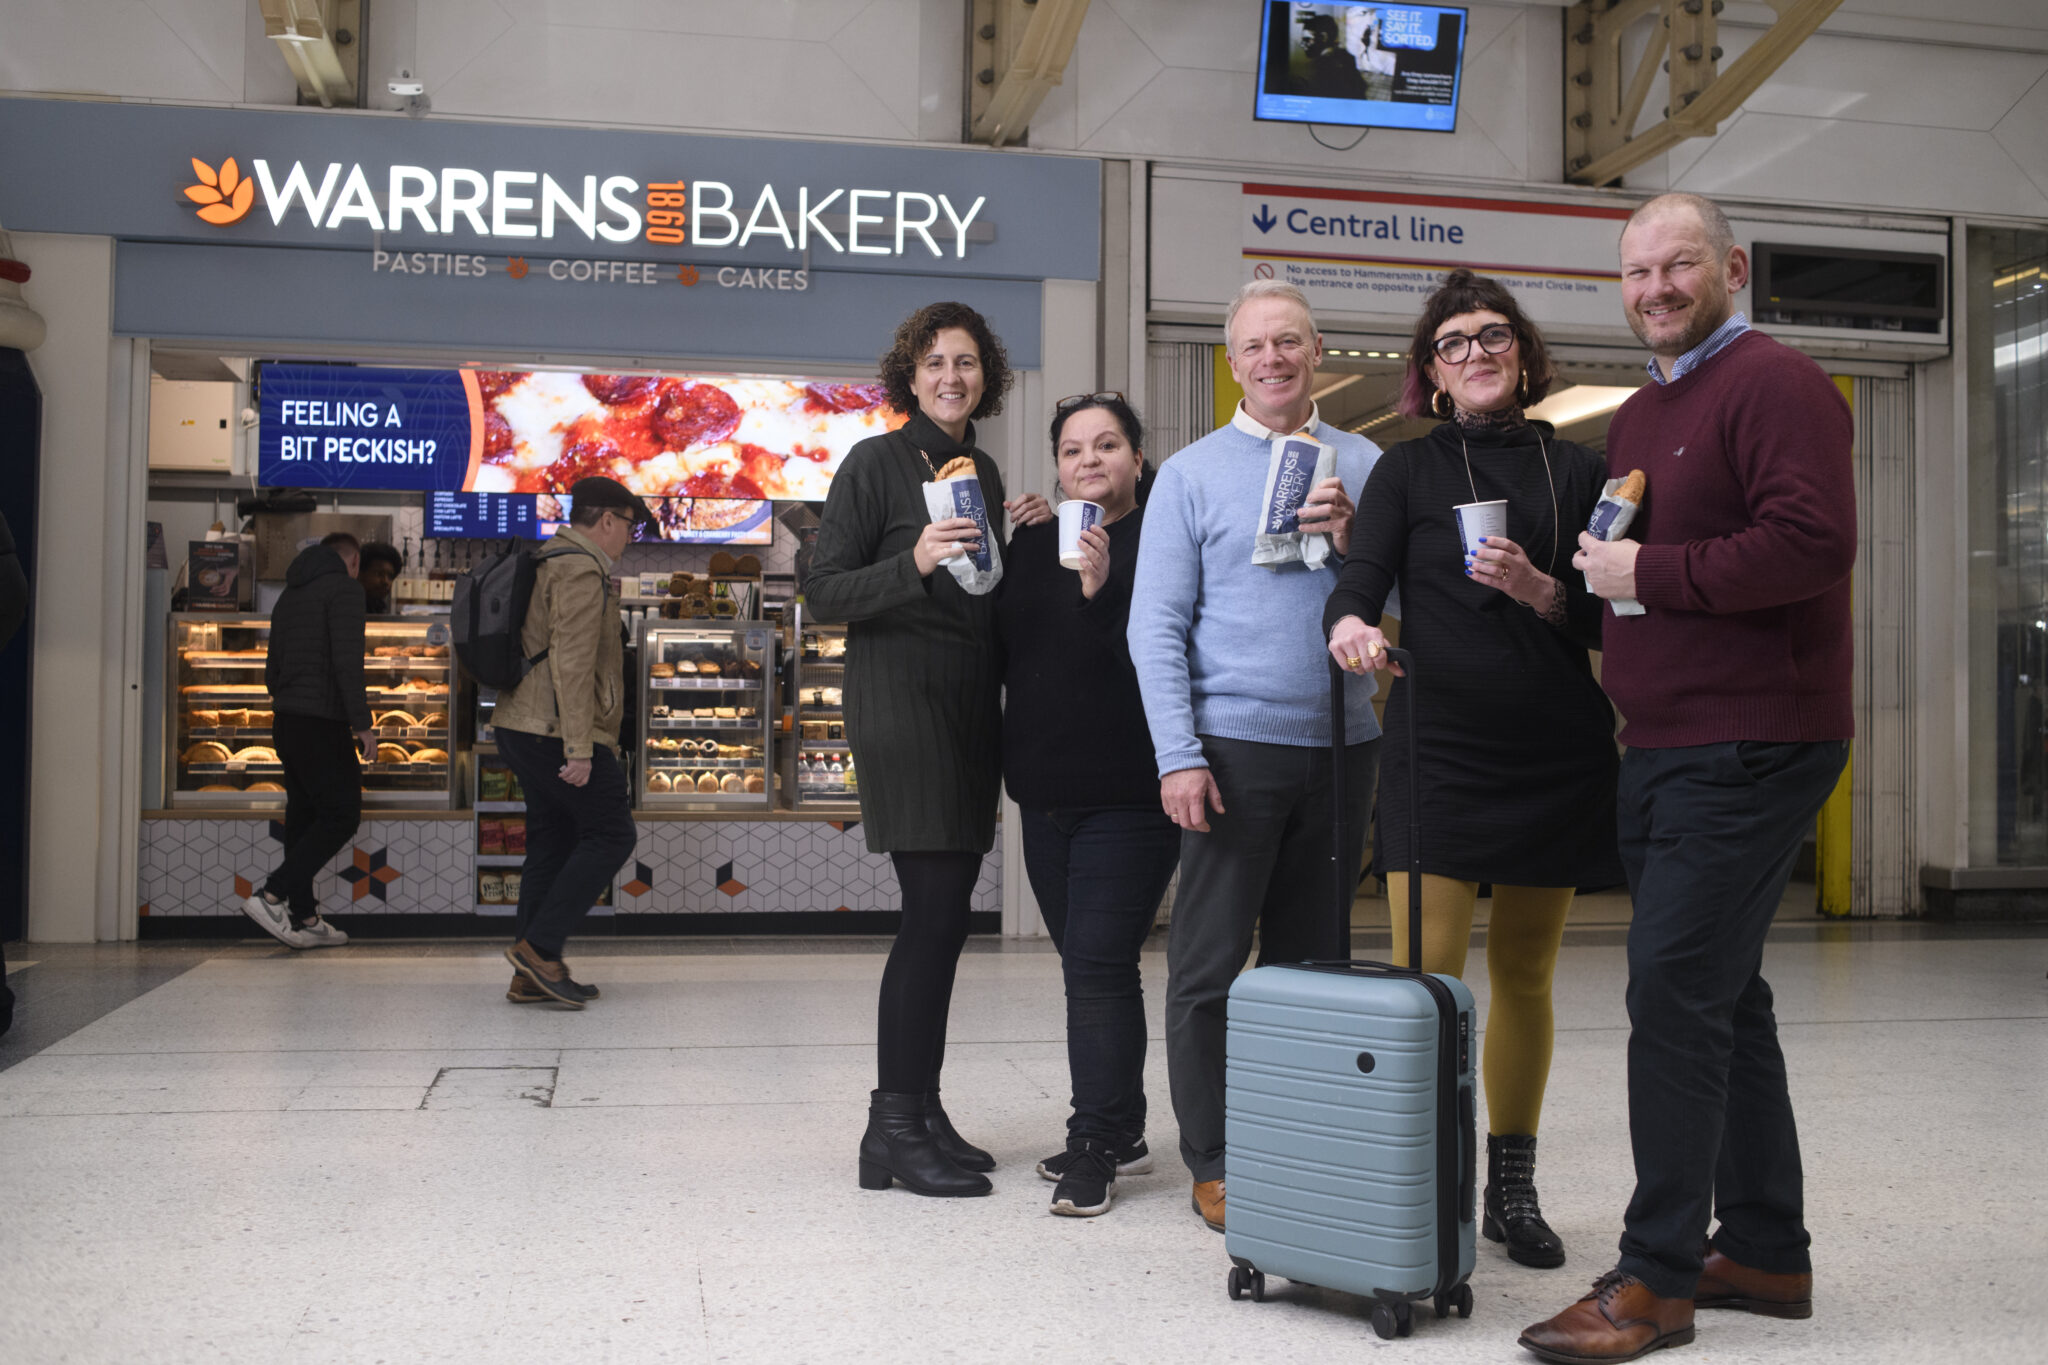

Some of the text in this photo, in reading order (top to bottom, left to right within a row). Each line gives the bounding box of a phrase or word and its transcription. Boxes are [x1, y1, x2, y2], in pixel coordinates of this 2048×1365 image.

[1385, 20, 1408, 32] SAY
[1386, 10, 1423, 23] SEE IT.
[1384, 32, 1434, 47] SORTED.
[253, 159, 986, 258] WARRENS 1860 BAKERY
[1287, 208, 1464, 244] Central line
[373, 250, 808, 291] PASTIES COFFEE CAKES
[1286, 264, 1301, 274] No
[1304, 267, 1337, 277] access
[1340, 267, 1351, 277] to
[1354, 268, 1423, 282] Hammersmith
[1426, 272, 1433, 282] &
[1525, 279, 1543, 289] and
[1545, 280, 1573, 291] Circle
[1575, 282, 1598, 293] lines
[1309, 278, 1353, 289] entrance
[1356, 281, 1369, 290] on
[1371, 282, 1415, 293] opposite
[281, 400, 402, 428] FEELING A
[281, 436, 437, 465] BIT PECKISH?
[1272, 458, 1297, 520] WARRENS
[1285, 468, 1308, 517] BAKERY
[972, 506, 988, 555] BAERY
